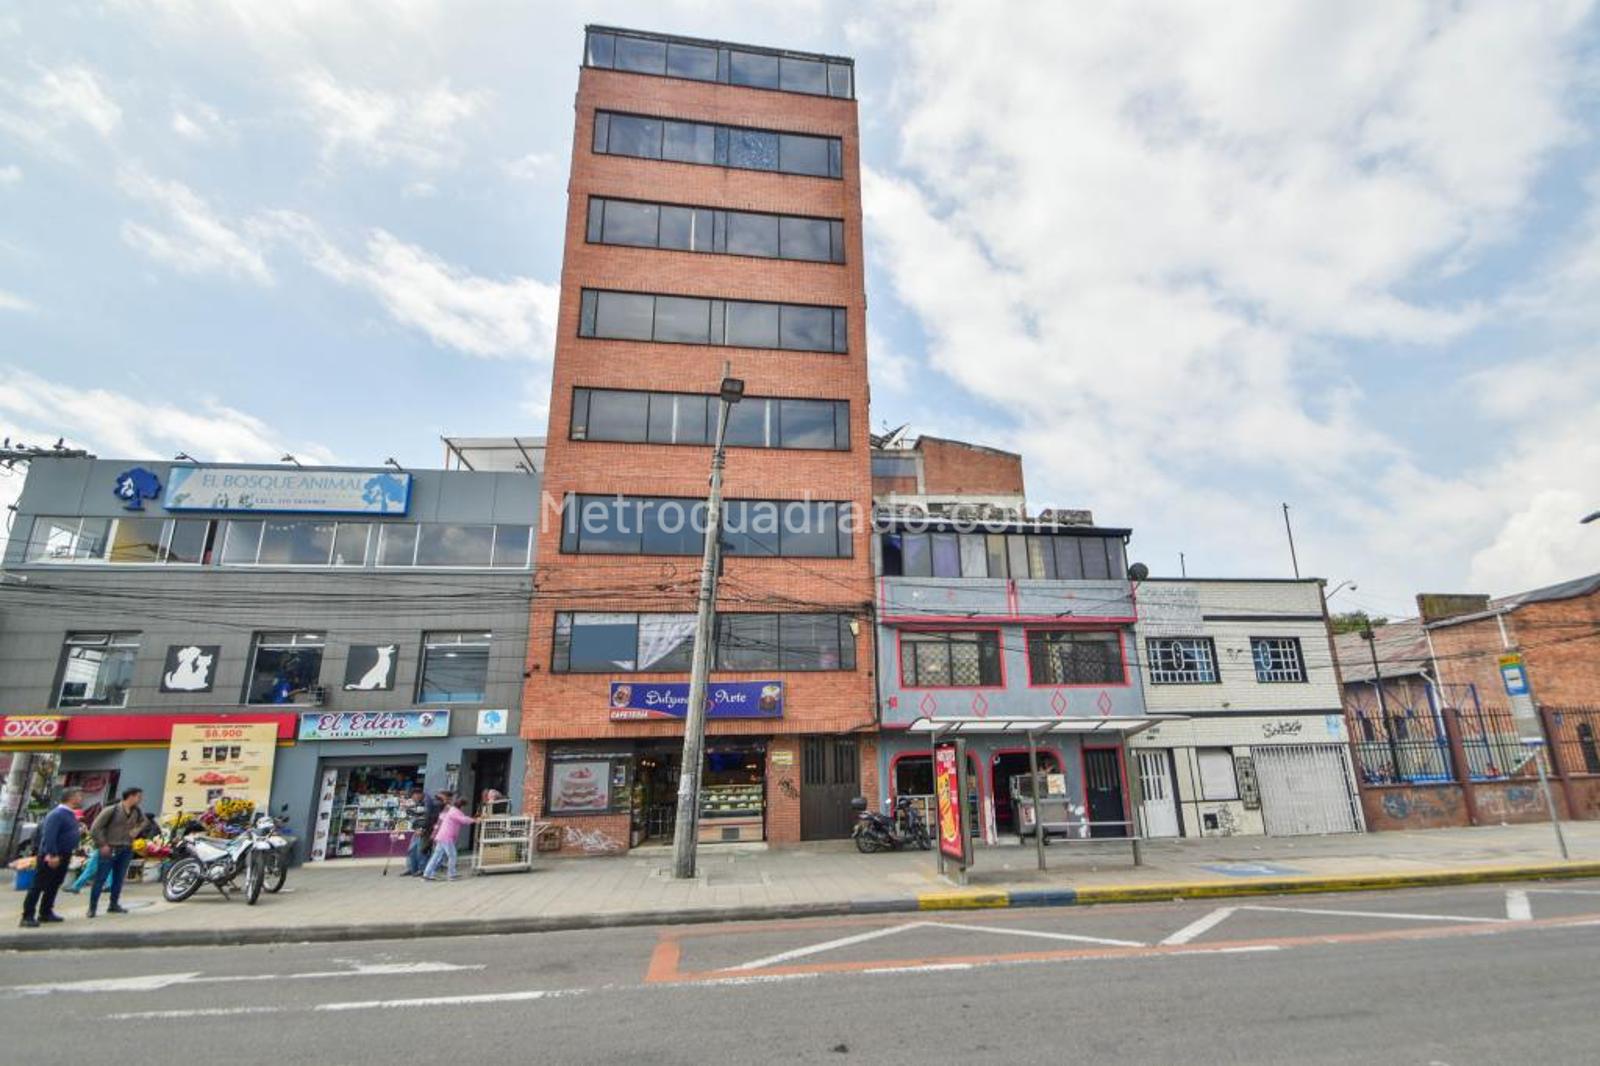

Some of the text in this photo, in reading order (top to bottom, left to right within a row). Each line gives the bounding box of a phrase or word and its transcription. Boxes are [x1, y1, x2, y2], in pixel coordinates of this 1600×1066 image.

[223, 475, 296, 490] BOSQUE
[299, 478, 360, 489] ANIMAL
[715, 689, 747, 703] Arte
[4, 720, 59, 736] OXXO
[318, 713, 344, 731] El
[180, 750, 188, 761] 1
[177, 773, 186, 784] 2
[174, 797, 183, 807] 3
